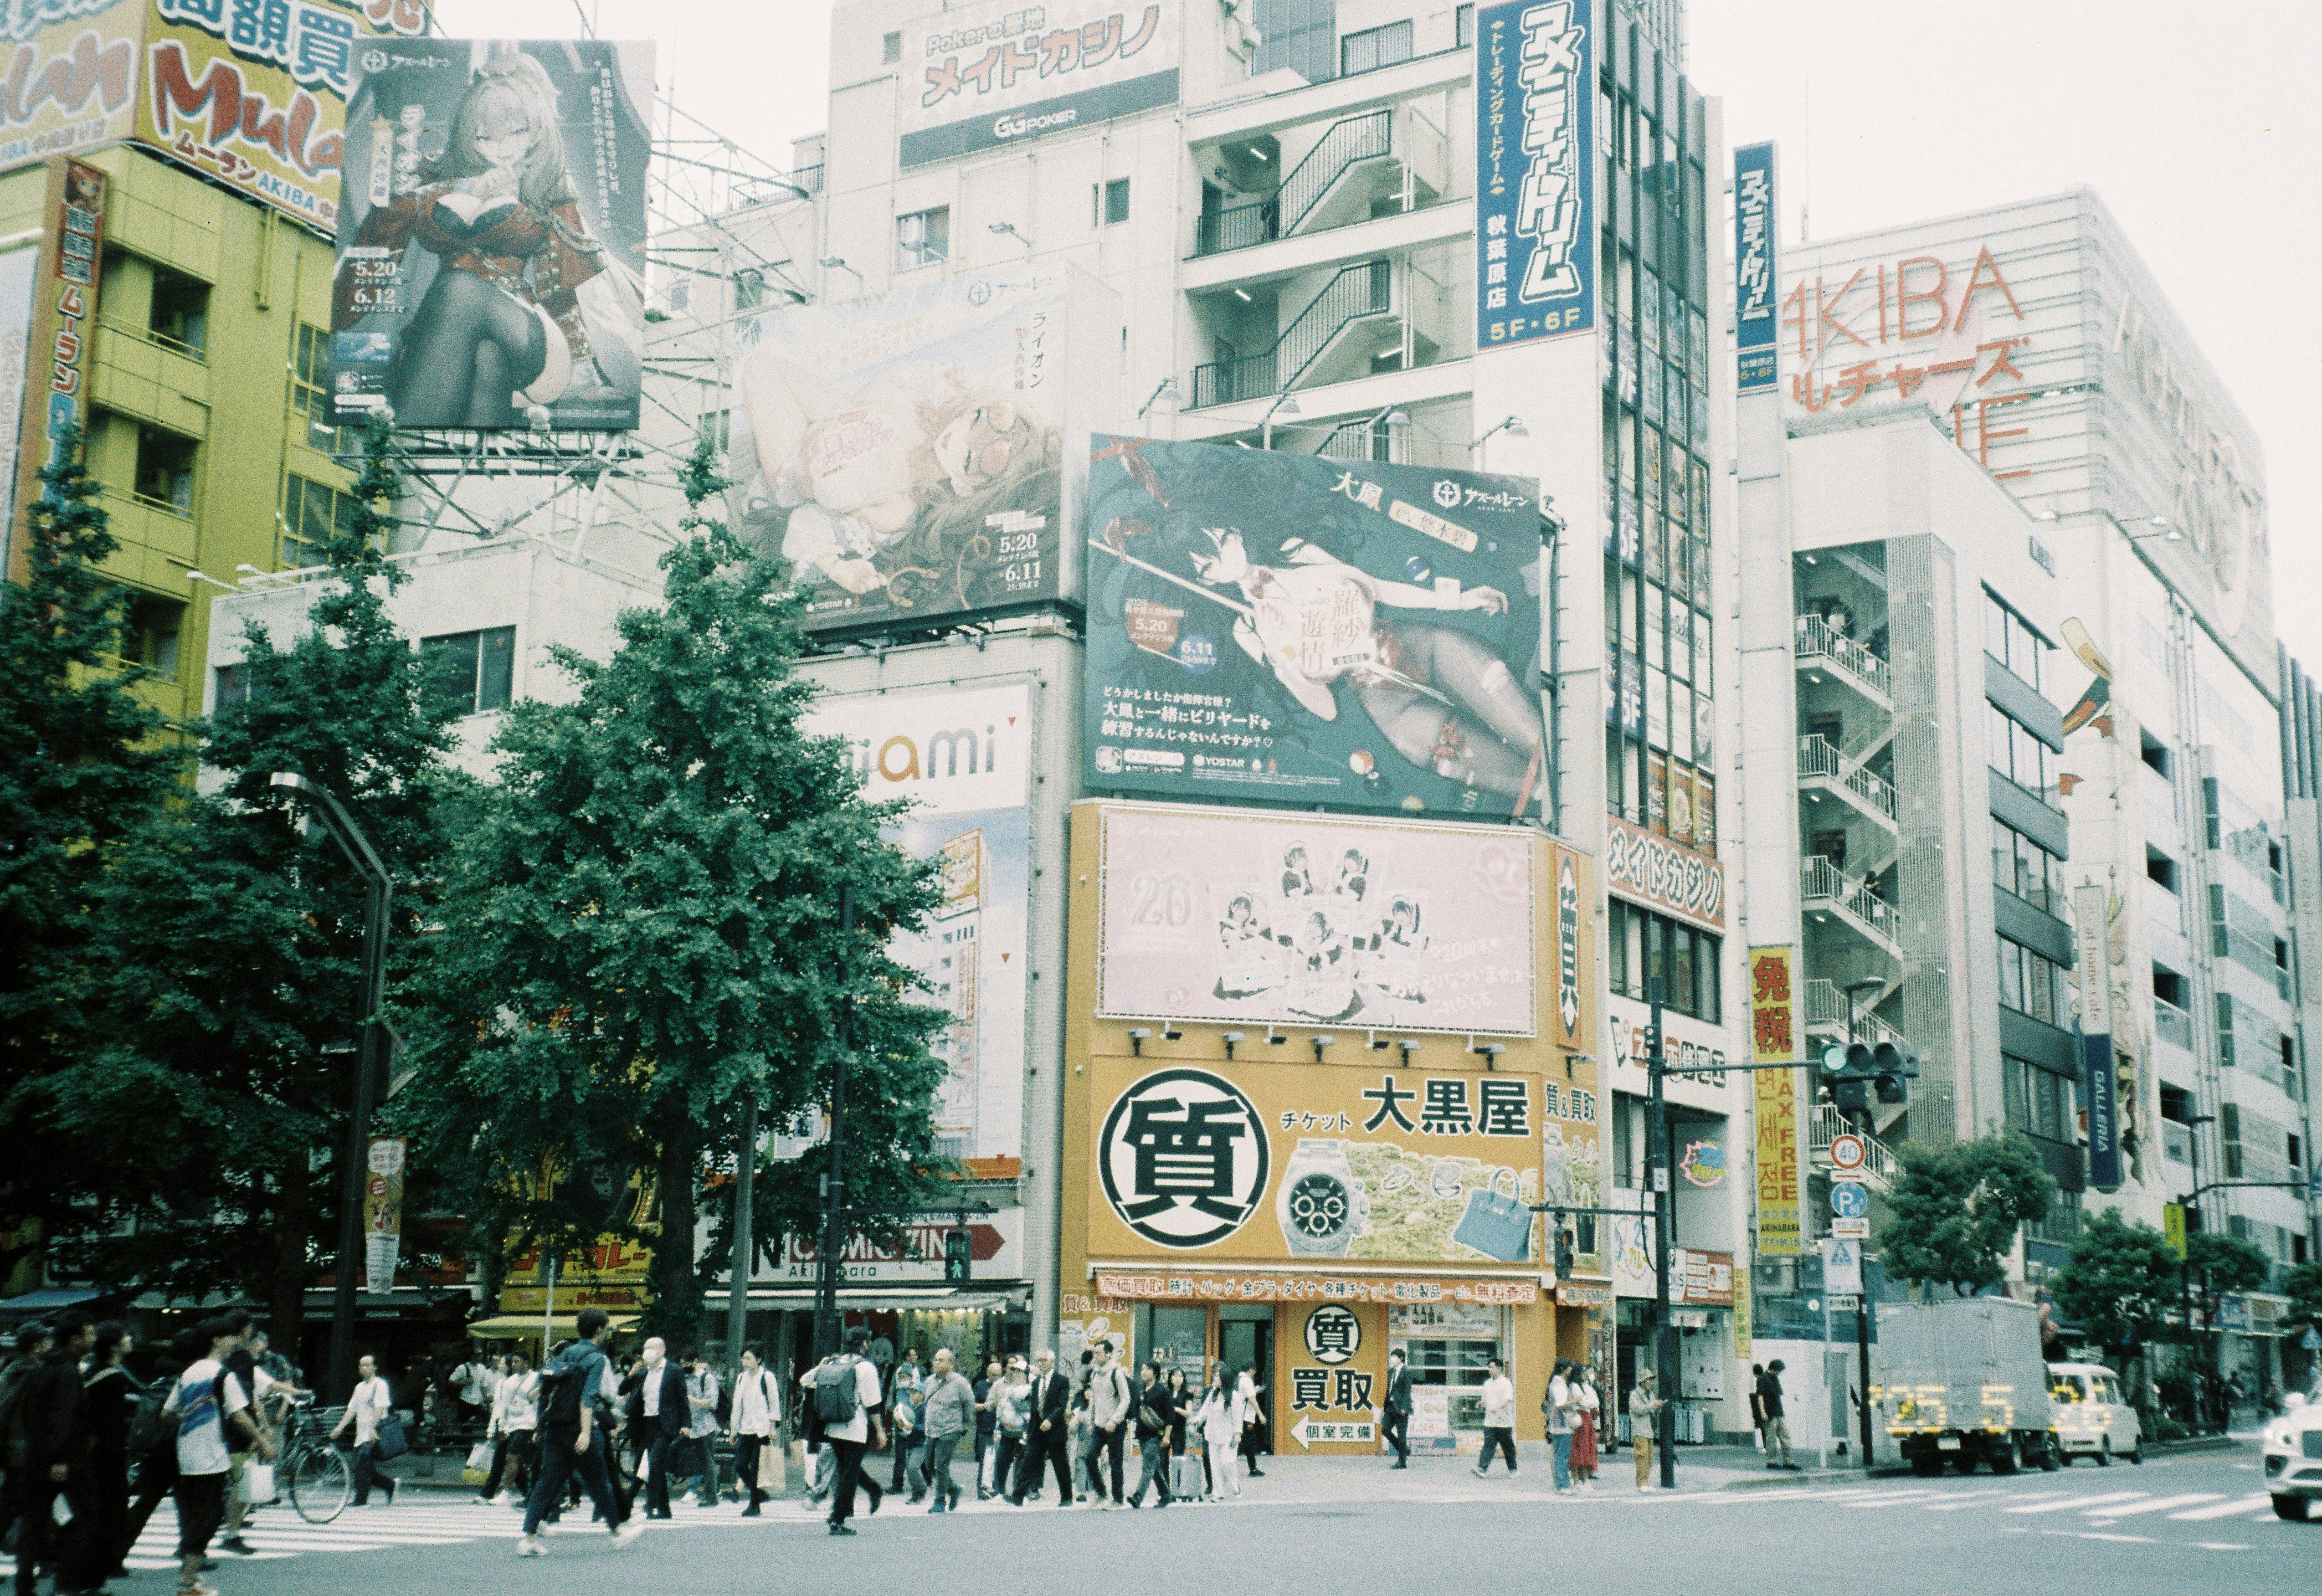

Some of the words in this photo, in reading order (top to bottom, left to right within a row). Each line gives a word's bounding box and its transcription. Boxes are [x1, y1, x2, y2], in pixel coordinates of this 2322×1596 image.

[923, 4, 1159, 108] メイドカジノ
[173, 130, 258, 181] ムーラン
[1518, 1, 1583, 302] アメニティドリーム
[257, 173, 315, 213] AKIBA
[1487, 215, 1507, 309] 秋葉原店
[355, 289, 395, 304] 6.12
[1783, 244, 2024, 359] AKIBA
[53, 285, 85, 395] ムーラン
[1030, 312, 1046, 388] ライオン
[1463, 487, 1528, 510] アズールレーン
[1000, 532, 1038, 554] 5.20
[1005, 561, 1041, 582] 6.11
[1134, 618, 1168, 633] 5.20
[1180, 640, 1214, 655] 6.11
[847, 724, 996, 786] iami
[1204, 756, 1245, 768] YOSTAR
[1609, 829, 1720, 918] メイドカジノ
[1753, 956, 1792, 1053] 免税
[1362, 1074, 1530, 1137] 大黒屋
[1777, 1066, 1795, 1118] TAX
[2093, 1070, 2109, 1153] GALLERIA
[1280, 1110, 1353, 1133] チケット
[1122, 1097, 1248, 1225] 質
[1781, 1128, 1799, 1202] FREE
[1839, 1145, 1858, 1160] 40
[793, 1230, 893, 1260] CMIC
[1476, 1284, 1536, 1302] 無料査定
[1312, 1313, 1355, 1356] 質
[1292, 1368, 1374, 1412] 買取
[1305, 1424, 1372, 1440] 個室完備
